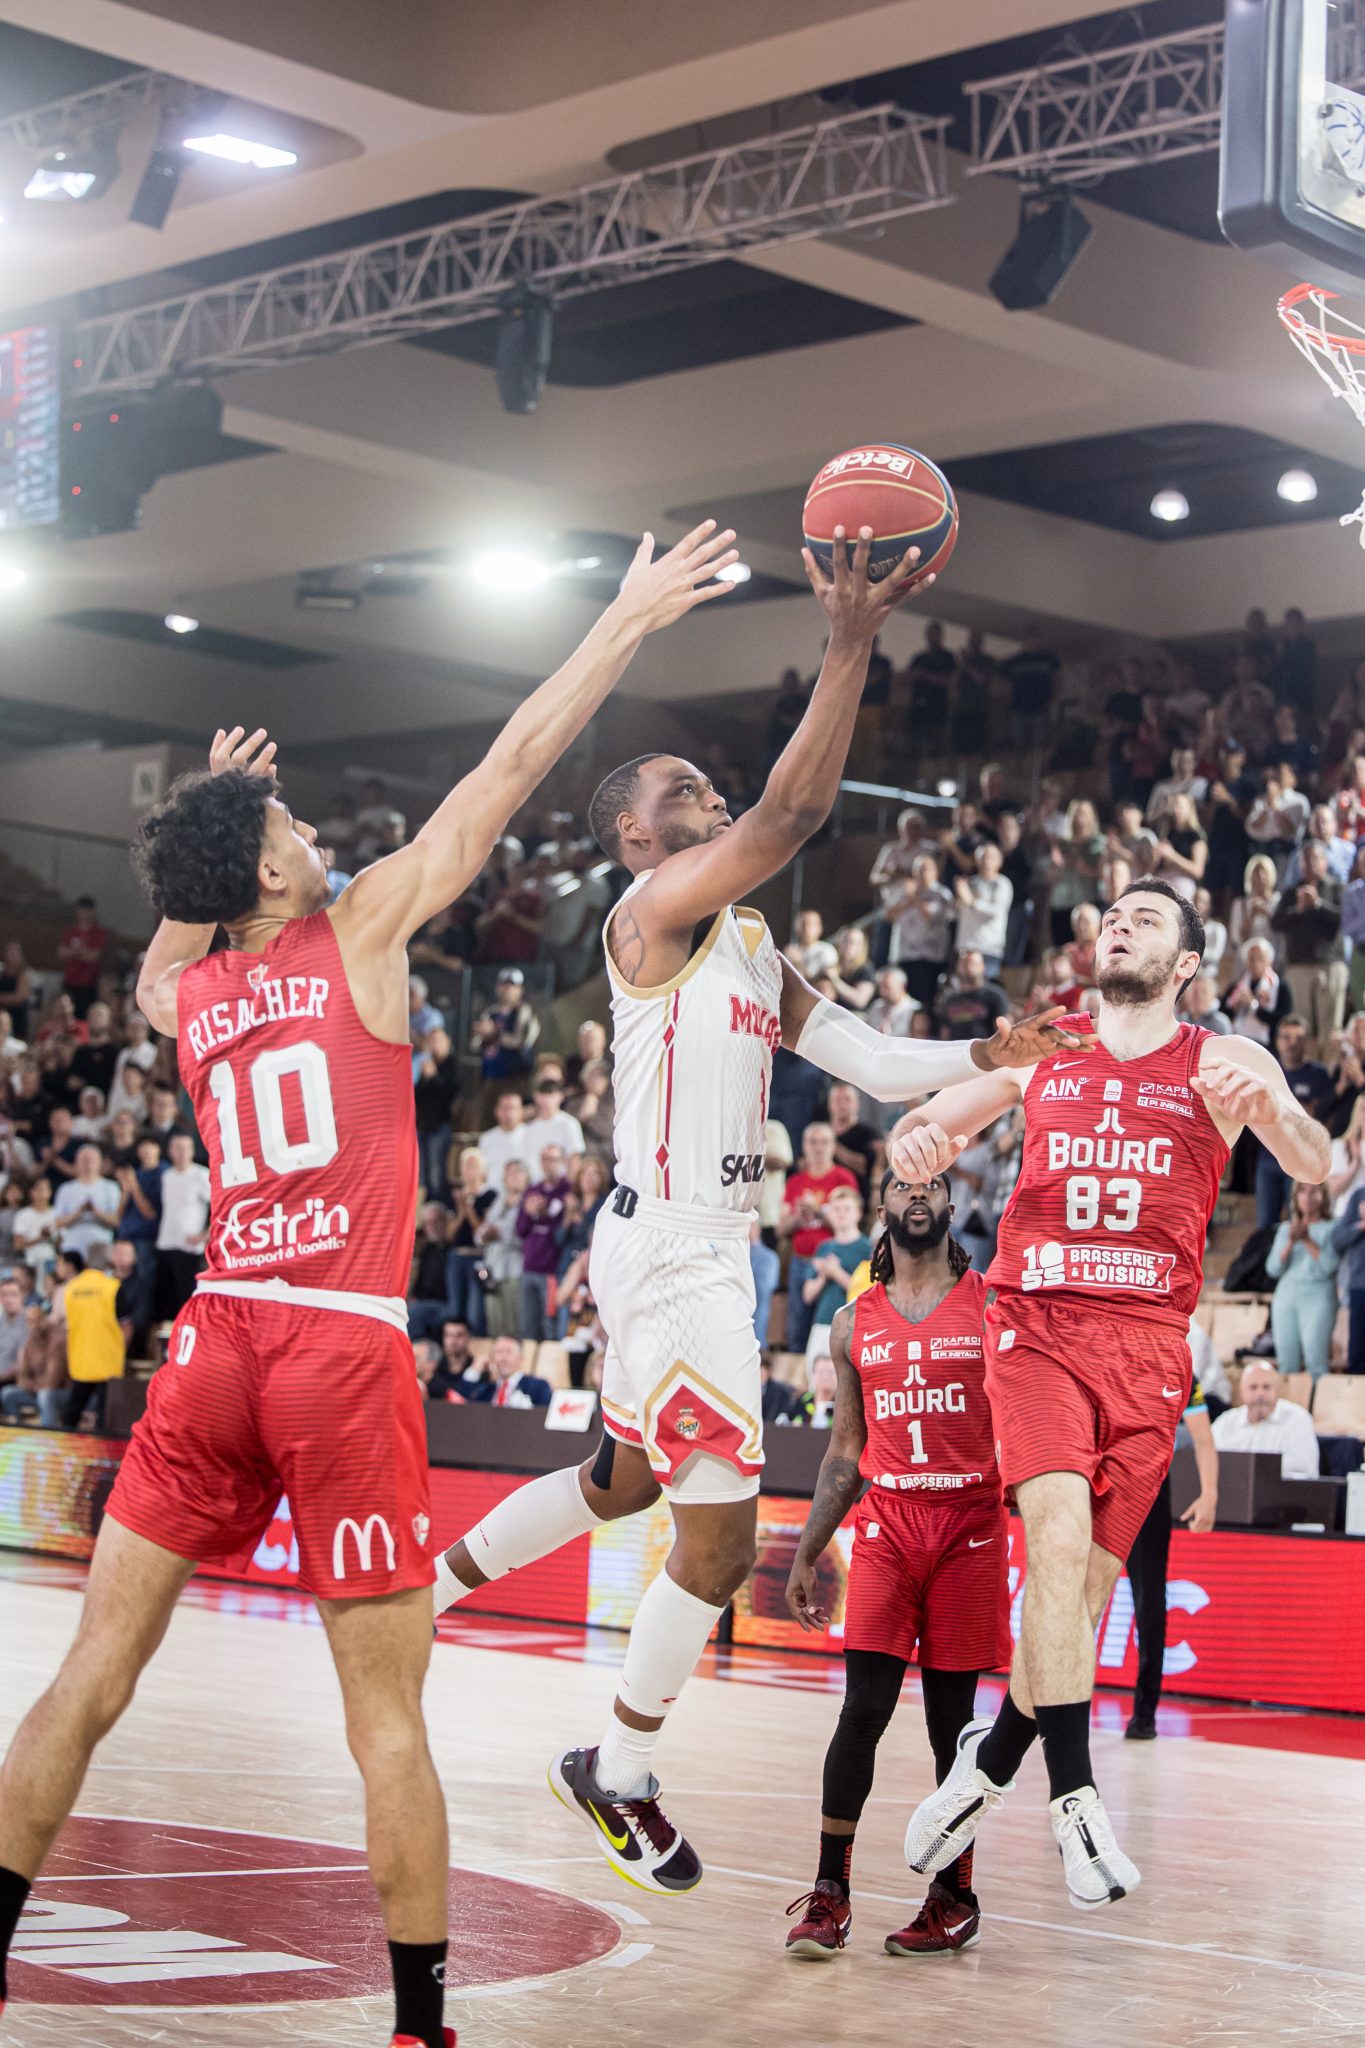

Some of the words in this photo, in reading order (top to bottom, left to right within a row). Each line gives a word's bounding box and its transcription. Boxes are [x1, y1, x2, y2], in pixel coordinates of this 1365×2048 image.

[824, 452, 909, 475] Betclic
[187, 976, 329, 1061] RISACHER
[1041, 1079, 1080, 1098] AIN
[208, 1040, 339, 1189] 10
[1048, 1132, 1174, 1176] BOURG
[1066, 1175, 1142, 1232] 83
[1070, 1249, 1155, 1270] BRASSERIE
[1083, 1264, 1158, 1287] LOISIRS
[861, 1345, 889, 1363] AIN
[874, 1383, 966, 1421] BOURG
[907, 1420, 929, 1464] 1
[900, 1477, 964, 1490] BRASSERIE
